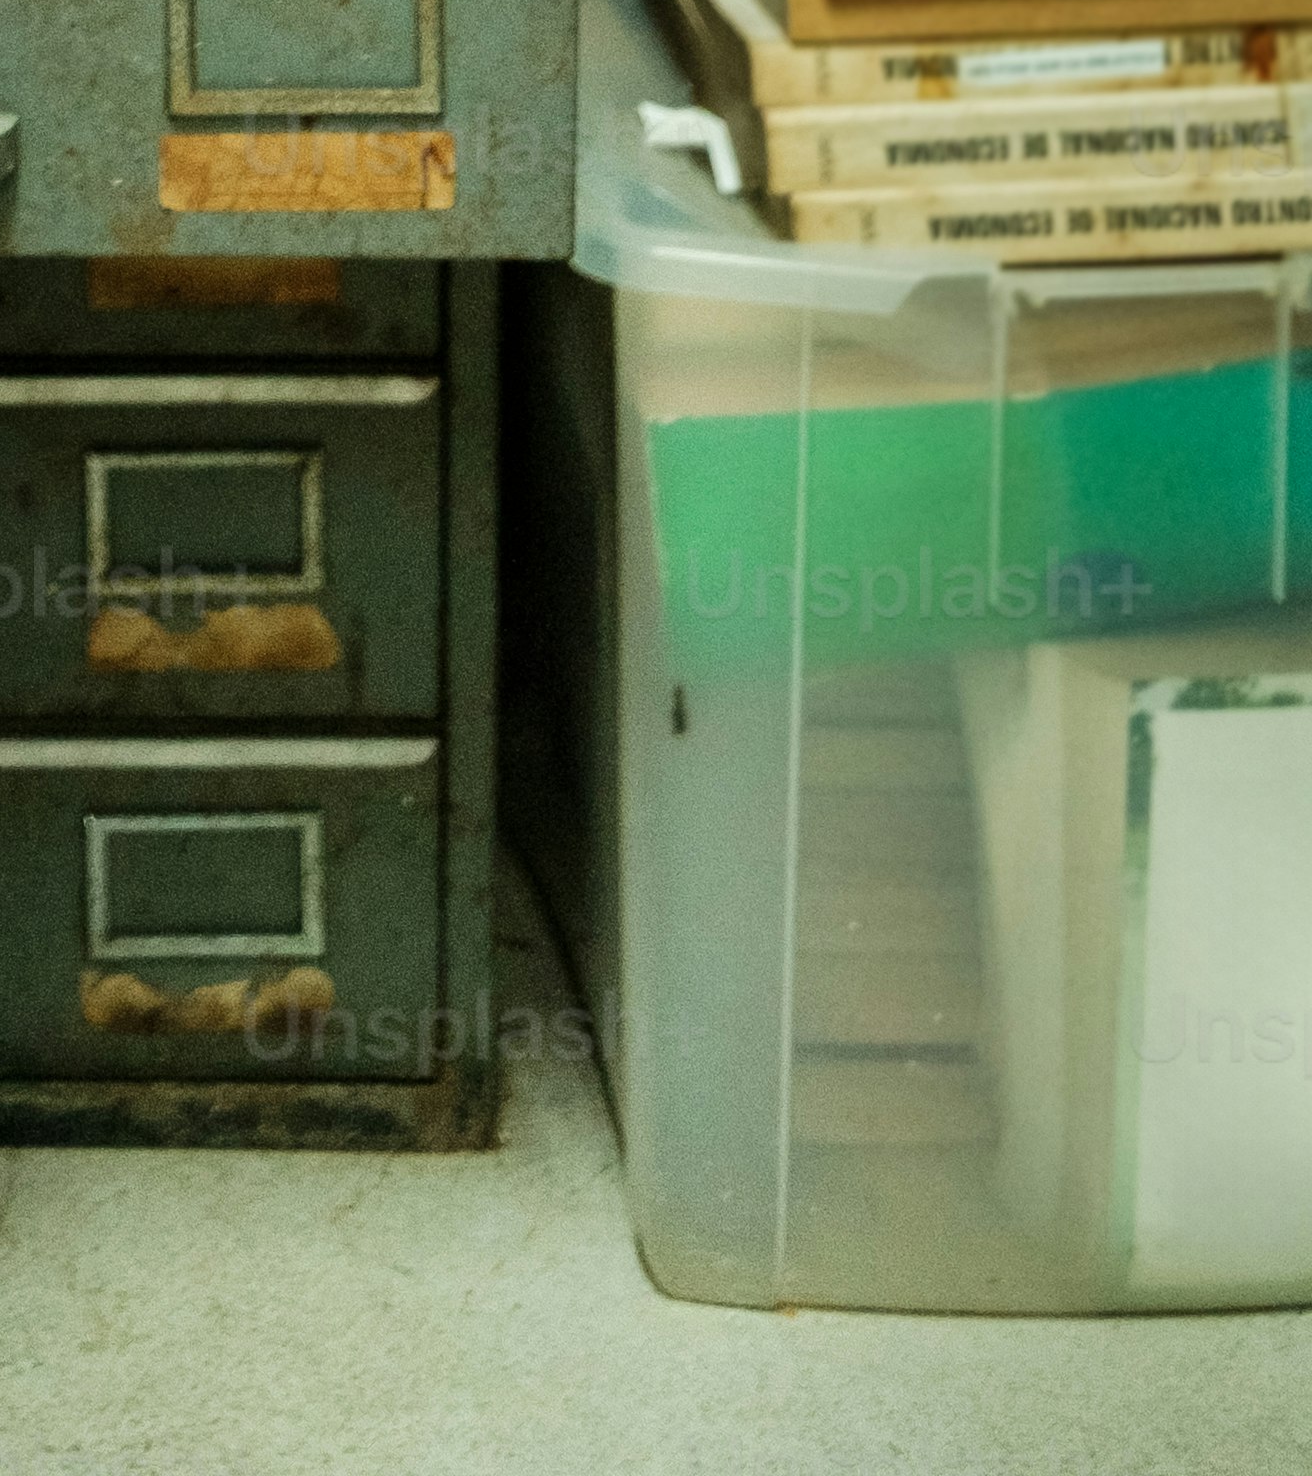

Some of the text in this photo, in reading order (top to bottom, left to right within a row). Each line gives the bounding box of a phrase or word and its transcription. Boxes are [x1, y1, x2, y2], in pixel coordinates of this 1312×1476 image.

[885, 136, 1010, 169] ECONOMIA
[1022, 132, 1049, 161] DE
[1060, 127, 1176, 158] NACIONAL
[928, 210, 1054, 243] ECONOMIA
[1066, 206, 1095, 237] DE
[1105, 202, 1223, 235] NACIONAL
